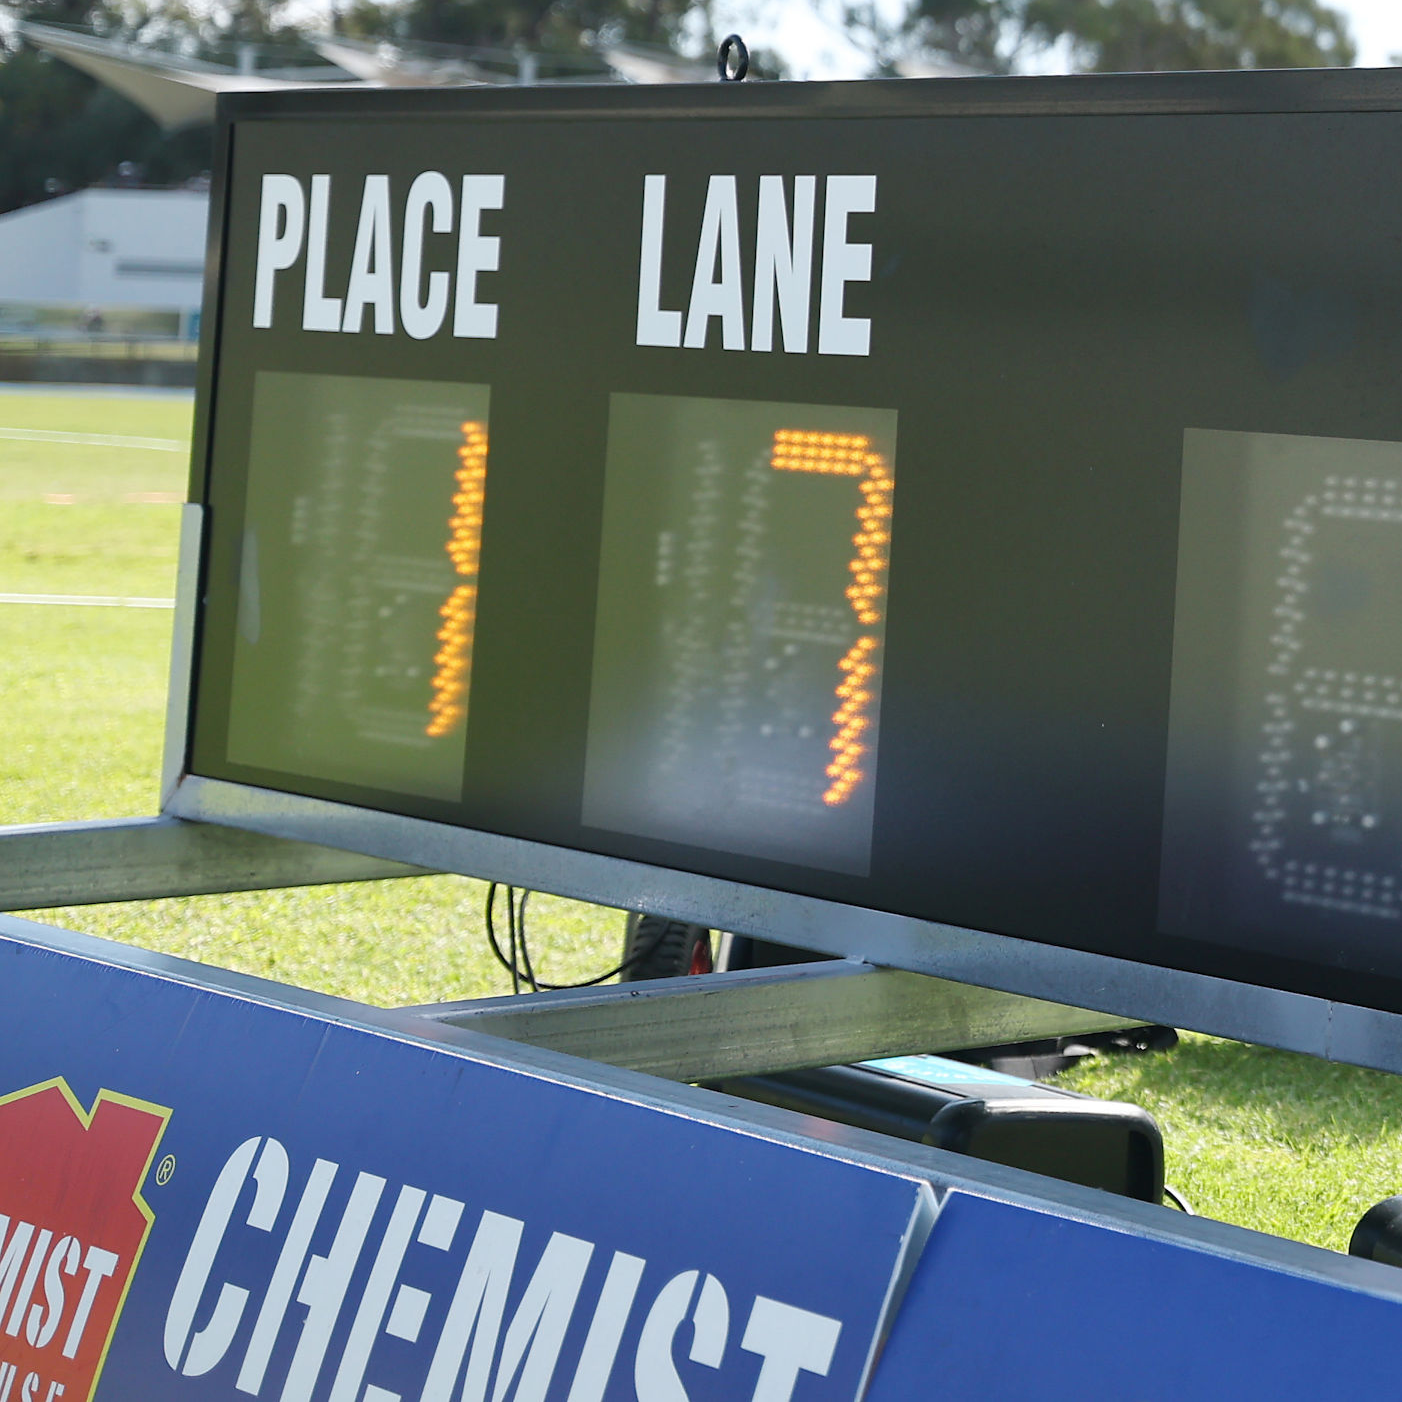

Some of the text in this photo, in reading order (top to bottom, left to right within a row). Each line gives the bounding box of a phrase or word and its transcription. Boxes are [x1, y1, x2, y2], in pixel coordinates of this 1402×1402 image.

[254, 172, 504, 339] PLACE
[636, 175, 876, 355] LANE
[427, 421, 488, 737] 1
[771, 429, 895, 806] 7
